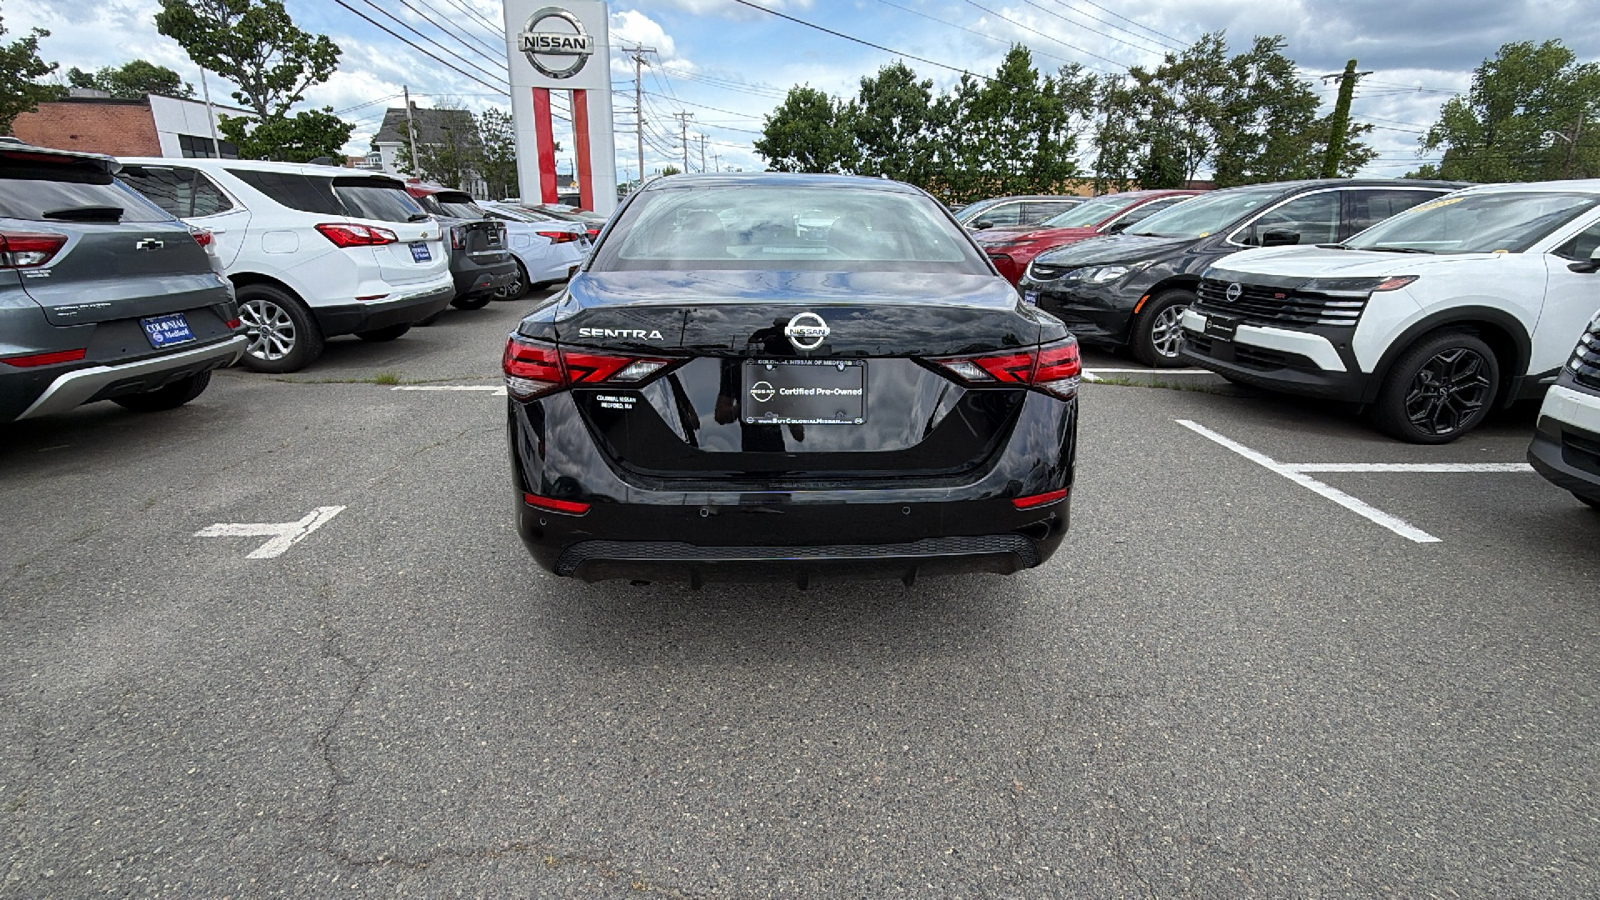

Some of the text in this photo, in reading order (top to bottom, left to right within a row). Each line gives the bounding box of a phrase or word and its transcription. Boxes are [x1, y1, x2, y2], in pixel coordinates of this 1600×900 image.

[524, 36, 586, 50] NISSAN
[146, 319, 188, 333] COLONIAL
[164, 328, 190, 339] Medford
[578, 328, 664, 341] SENTRA
[789, 328, 826, 336] NISSAN
[779, 387, 863, 396] Certified Pre-Owned
[596, 394, 619, 402] COLONIAL
